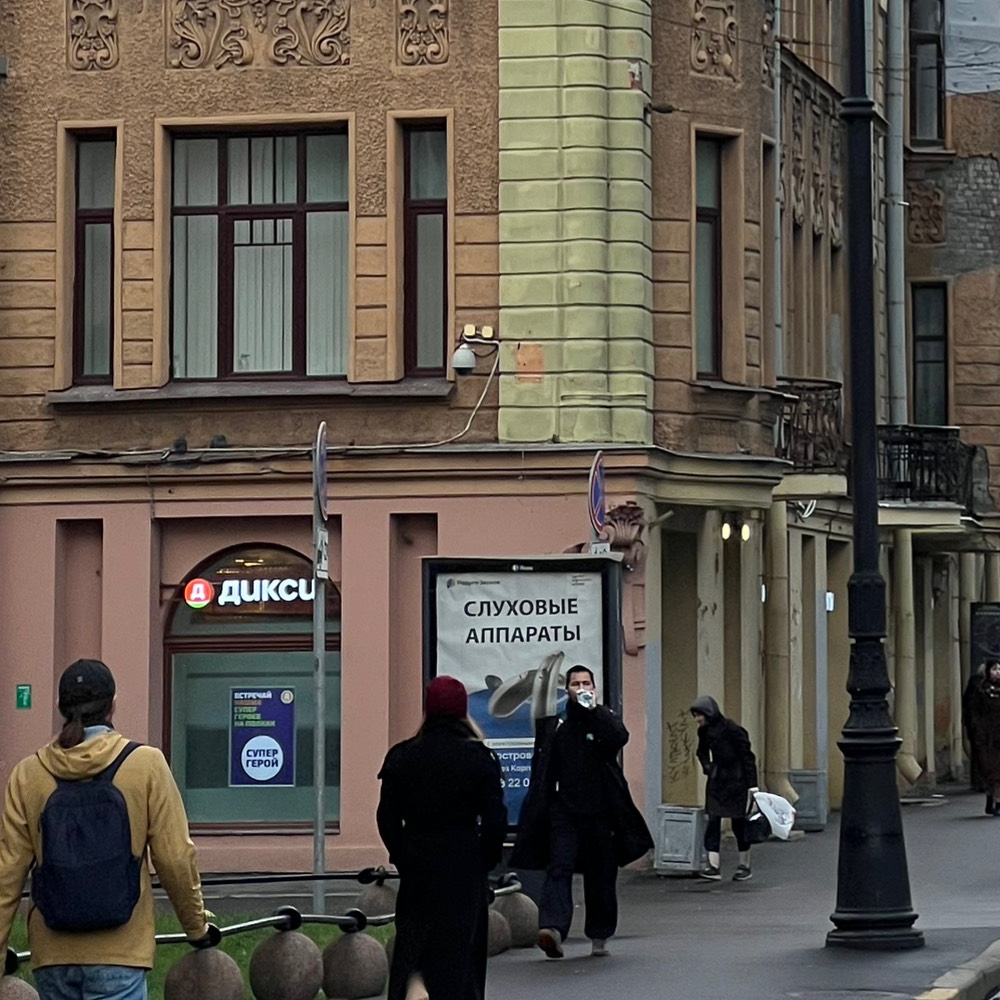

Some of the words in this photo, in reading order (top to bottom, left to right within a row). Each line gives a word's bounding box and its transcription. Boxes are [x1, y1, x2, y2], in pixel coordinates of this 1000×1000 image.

[190, 583, 206, 601] Д
[464, 598, 578, 617] СЛУХОВЫЕ
[465, 625, 581, 644] АППАРАТЫ
[234, 690, 272, 699] ВСТРЕЧАЙ
[246, 749, 278, 758] СУПЕР
[246, 758, 279, 768] ГЕРОЙ
[508, 778, 521, 788] 22
